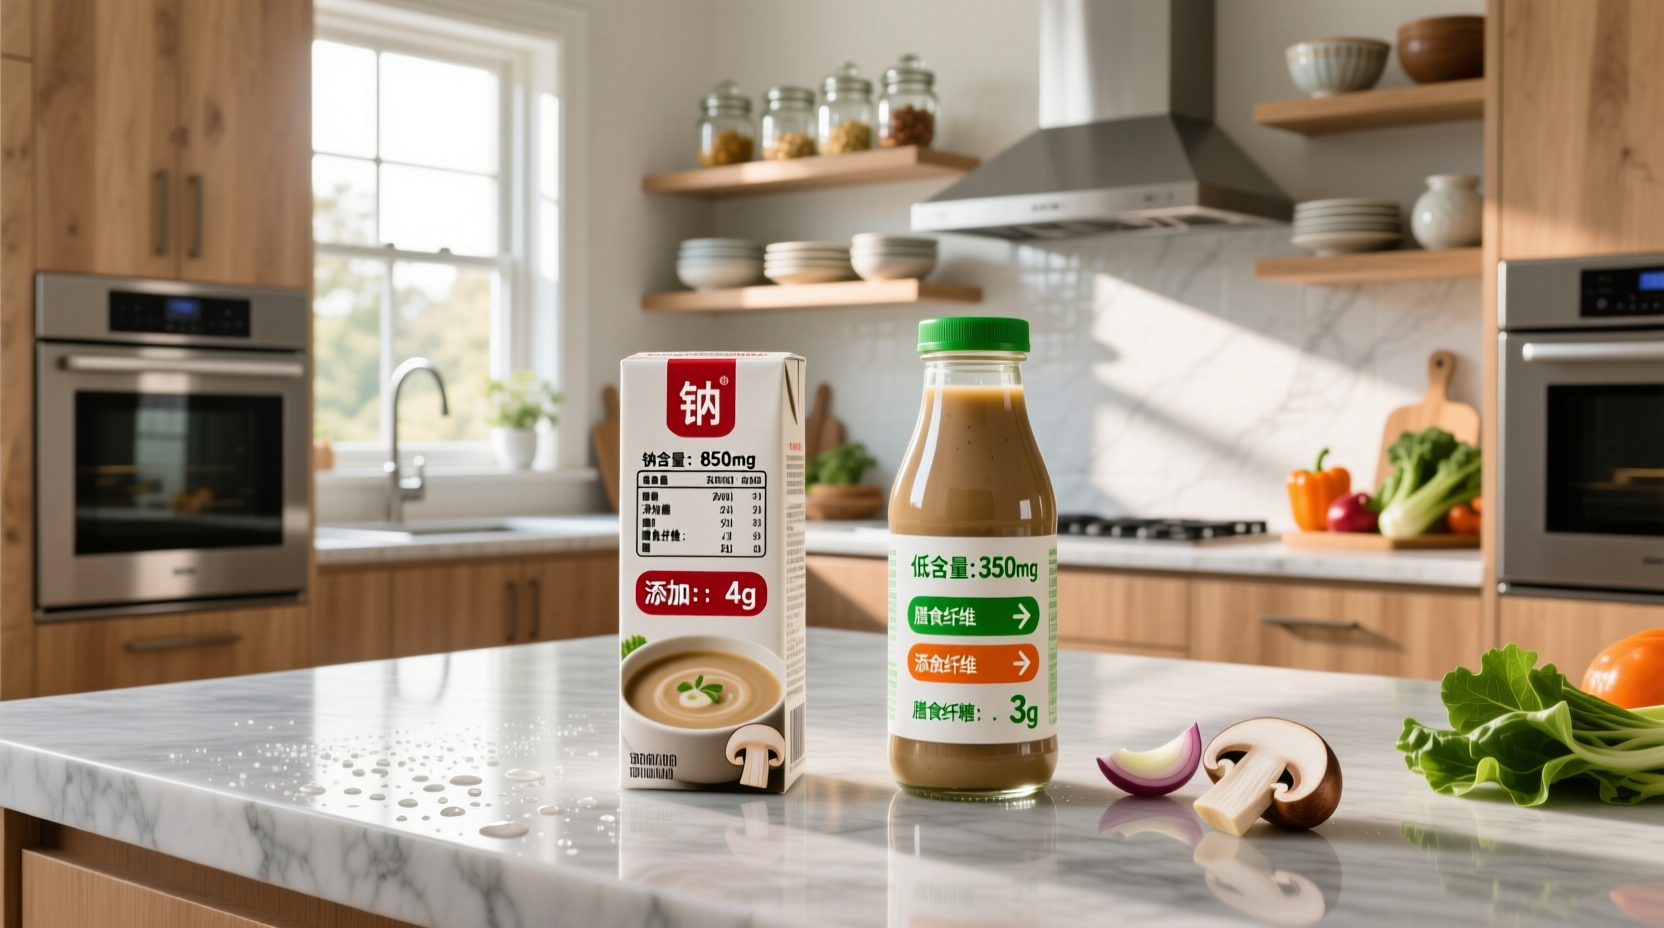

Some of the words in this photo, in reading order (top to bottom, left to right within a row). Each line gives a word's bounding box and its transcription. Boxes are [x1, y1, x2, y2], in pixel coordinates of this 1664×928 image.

[679, 381, 720, 426] 钠
[700, 451, 756, 470] 850mg
[725, 581, 756, 610] 4g
[1009, 694, 1038, 729] 3g
